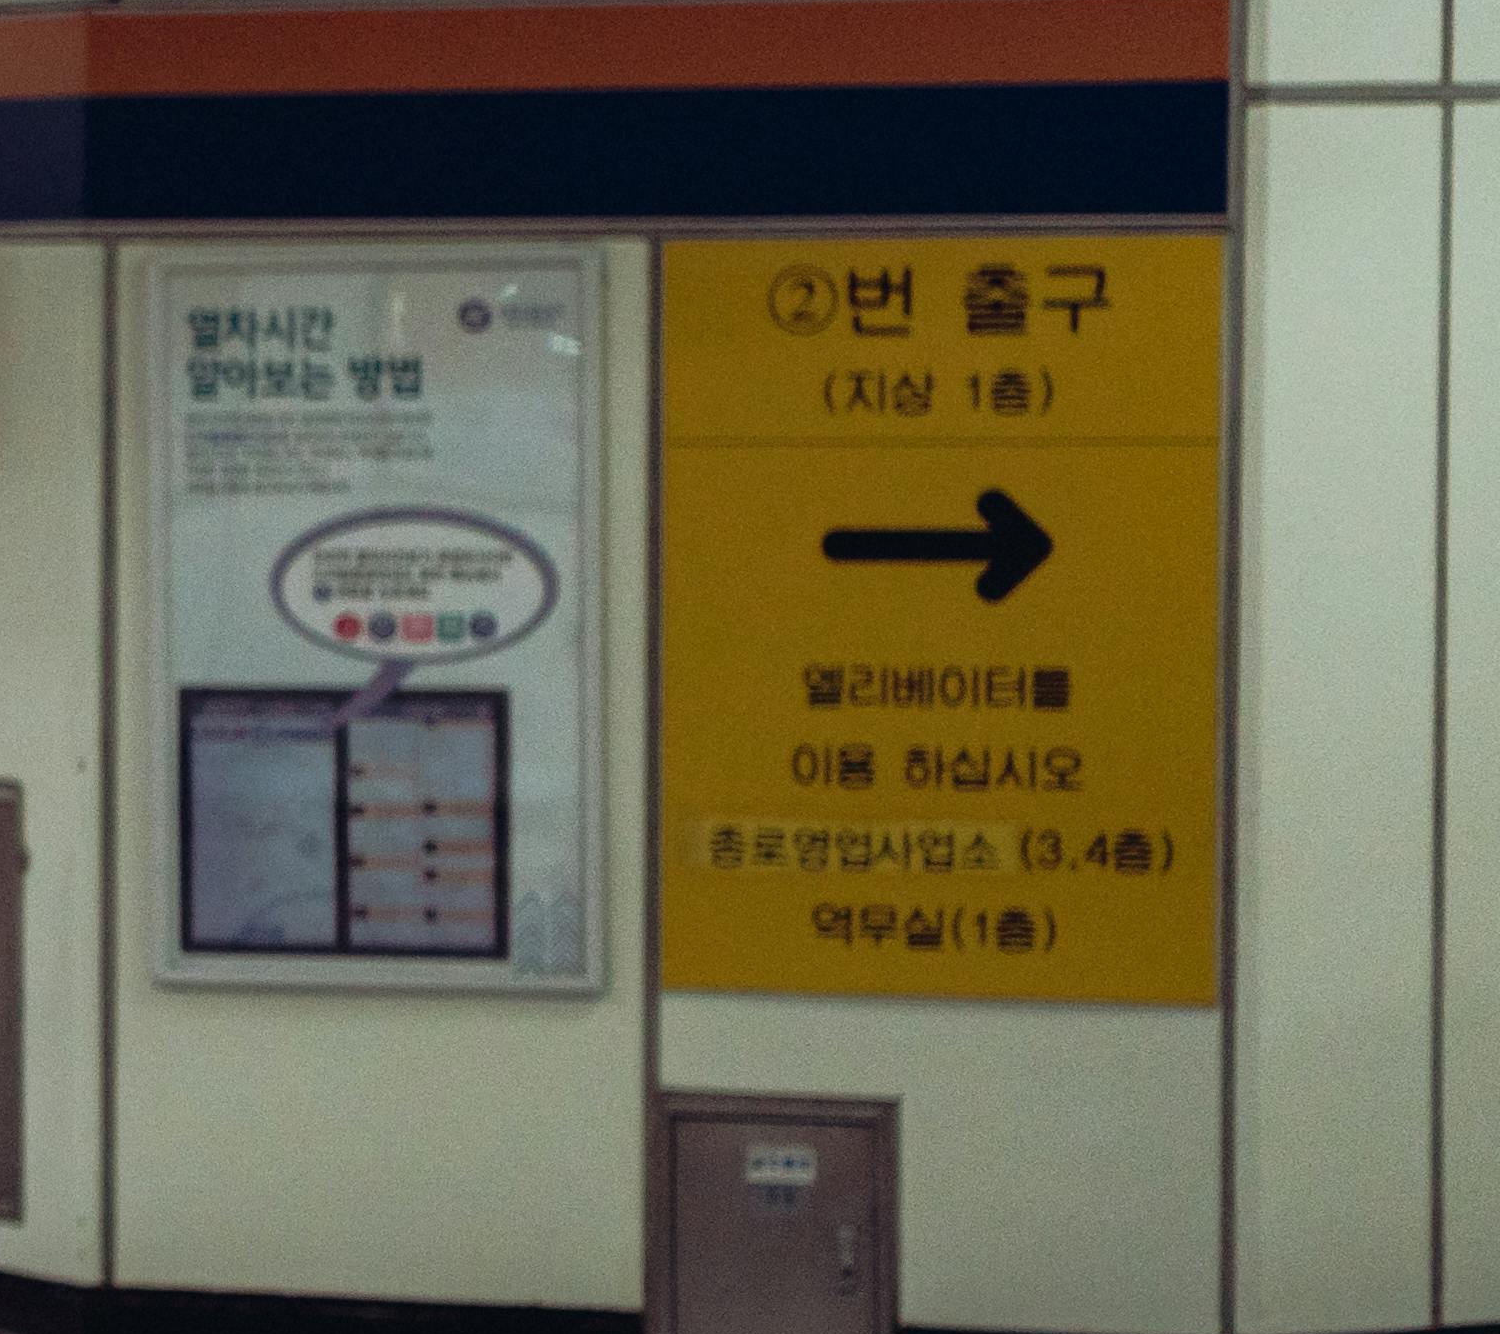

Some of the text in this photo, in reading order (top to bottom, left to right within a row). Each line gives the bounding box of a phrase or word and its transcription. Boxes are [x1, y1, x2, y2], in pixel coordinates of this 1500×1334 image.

[962, 262, 1112, 337] 출구
[186, 304, 334, 353] 열차시간
[347, 352, 424, 402] 방법
[822, 367, 1055, 417] (지상 1층)
[803, 662, 1071, 711] 엘리베이터를
[791, 741, 1085, 792] 이용 하십시오
[709, 822, 1000, 873] 종로영업사업소
